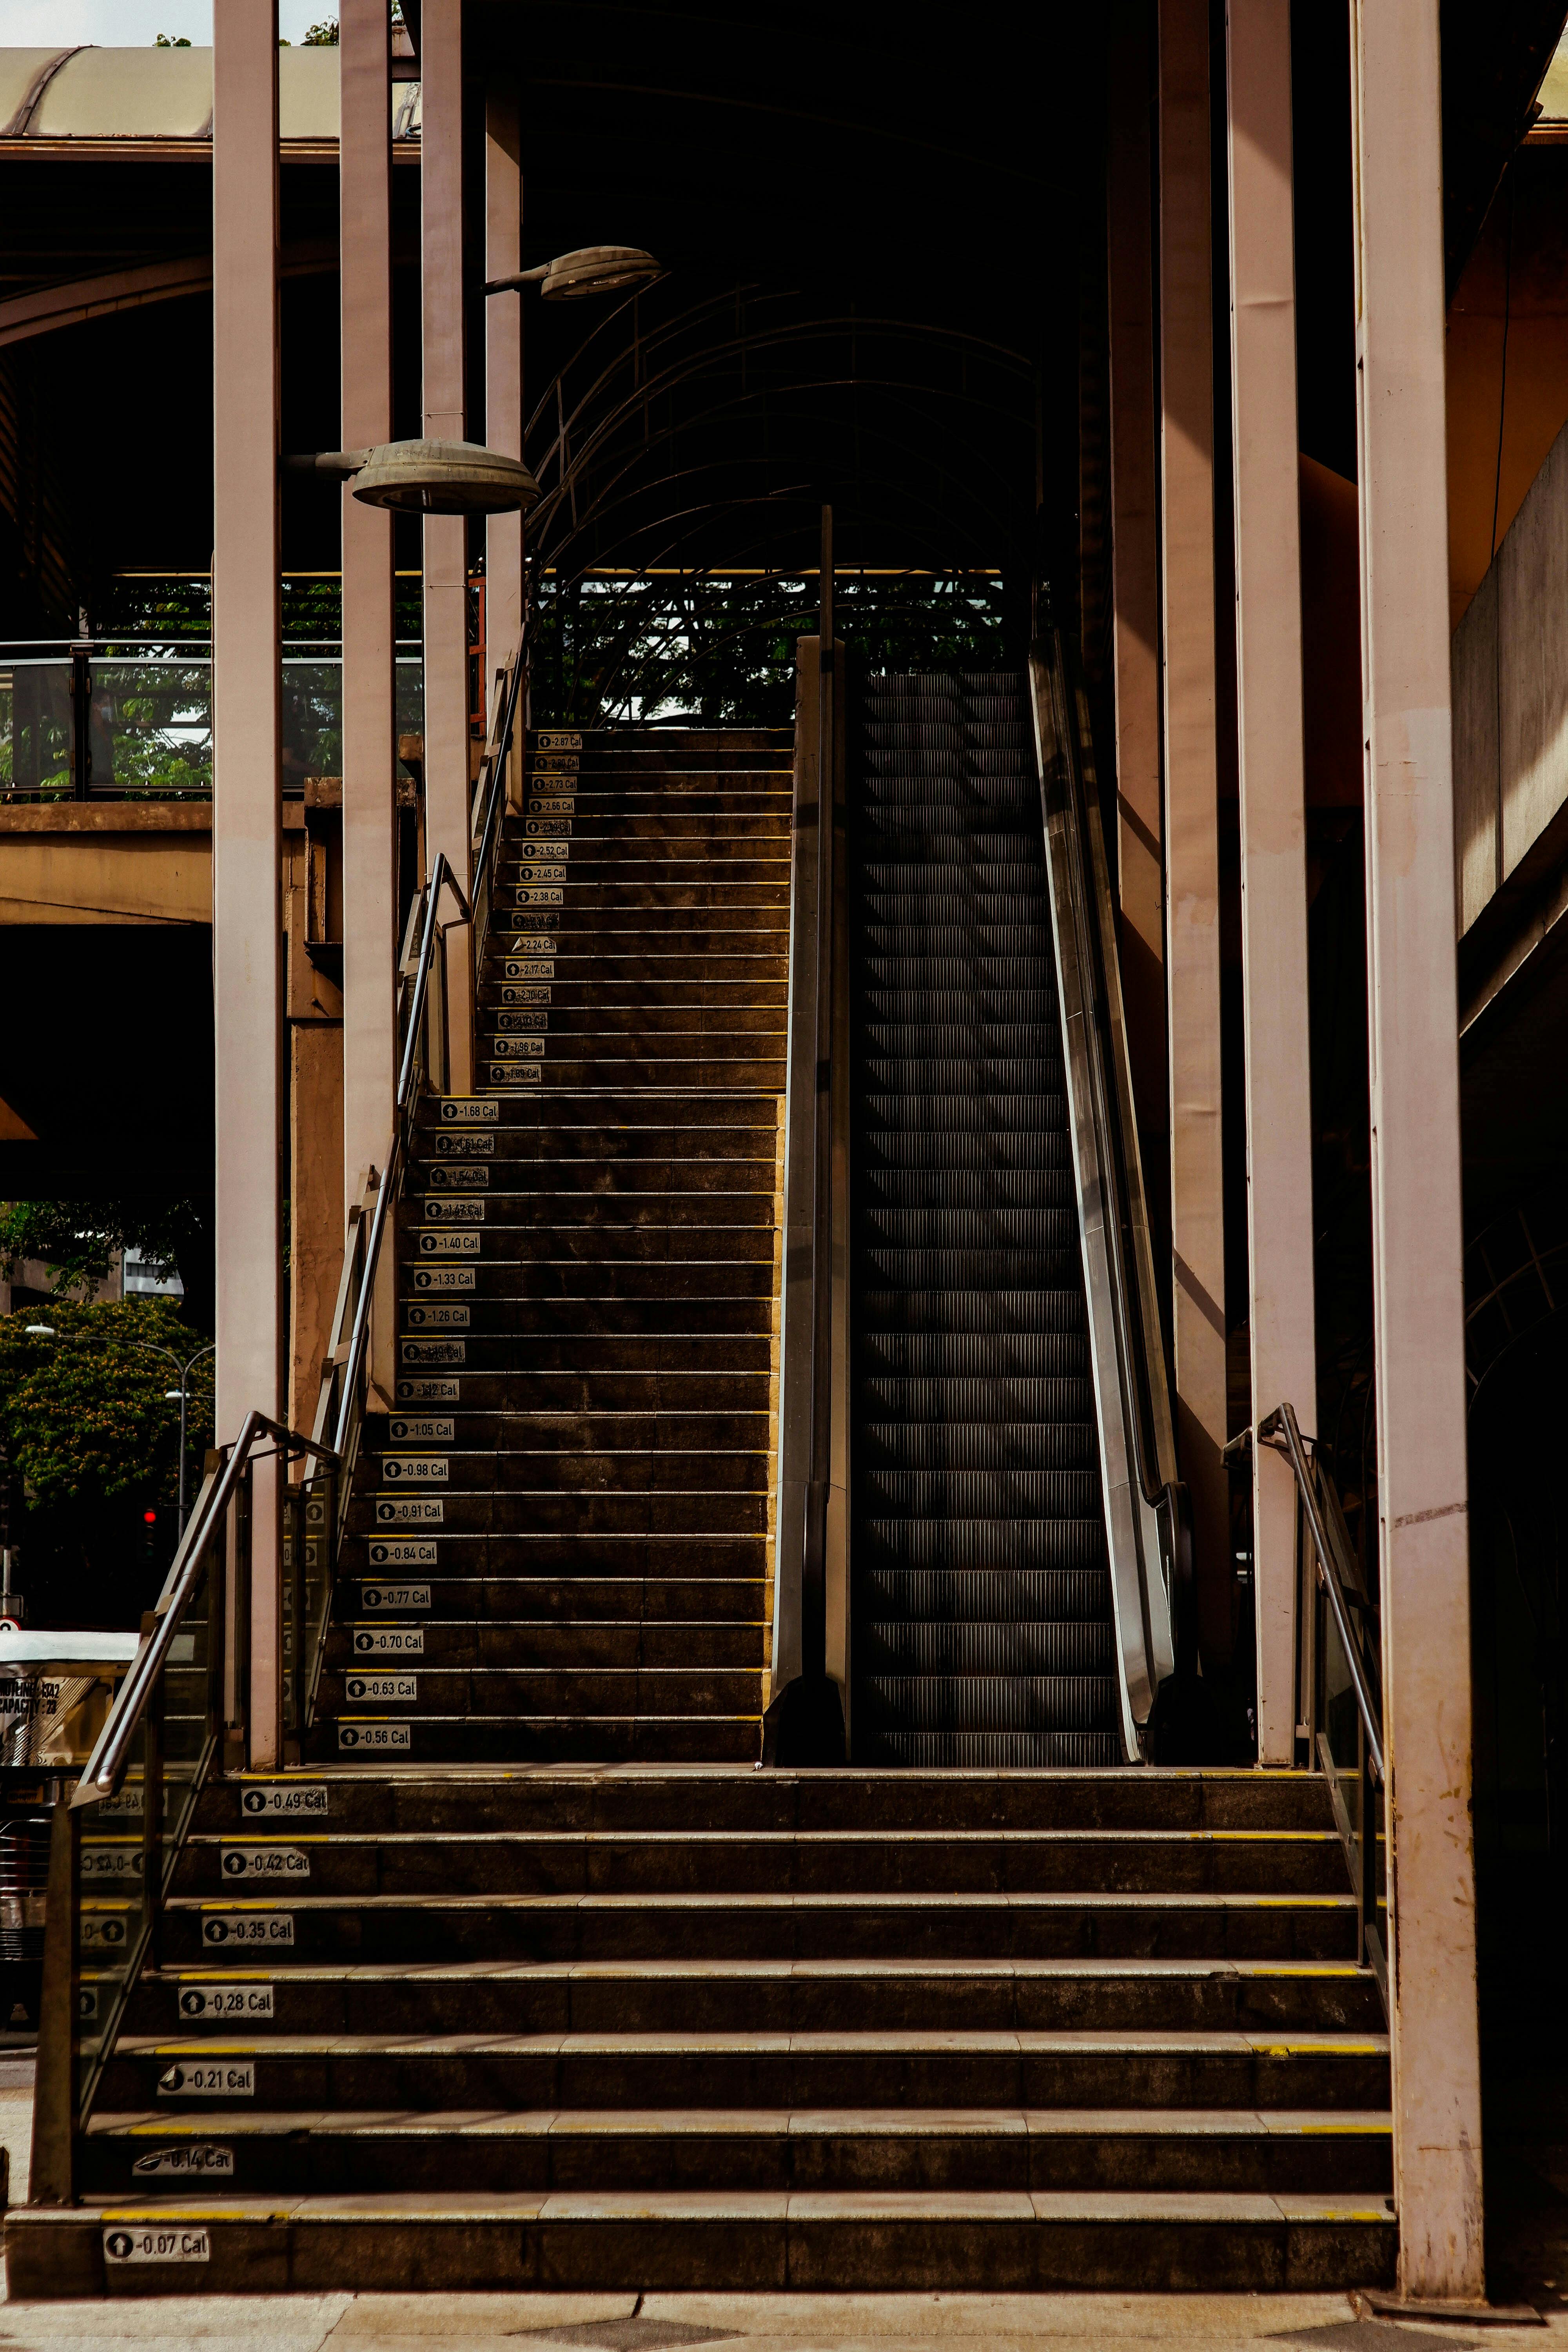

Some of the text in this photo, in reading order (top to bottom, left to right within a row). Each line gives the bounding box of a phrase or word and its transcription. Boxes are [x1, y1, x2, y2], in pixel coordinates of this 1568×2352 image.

[552, 738, 581, 746] -2.87 Cal
[543, 801, 573, 810] -2.66 Cal
[537, 846, 567, 855] -2.52 Cal
[534, 869, 565, 878] -2.45 Cal
[531, 892, 562, 901] -2.38 Cal
[523, 940, 555, 949] -2.24 Cal
[521, 965, 552, 974] -2.17 Cal
[511, 1042, 542, 1052] -1.96 Cal
[527, 1069, 539, 1078] Cal
[459, 1106, 496, 1117] -1.68 Cal
[472, 1171, 486, 1181] Cal
[444, 1204, 482, 1215] -1.47 Cal
[439, 1237, 477, 1249] -1.40 Cal
[434, 1273, 473, 1285] -1.33 Cal
[428, 1310, 467, 1322] -1.26 Cal
[441, 1384, 456, 1396] Cal
[410, 1424, 452, 1436] -1.05 Cal
[403, 1464, 446, 1476] -0.98 Cal
[397, 1505, 440, 1518] -0.91 Cal
[390, 1547, 435, 1560] -0.84 Cal
[383, 1591, 429, 1604] -0.77 Cal
[375, 1635, 422, 1649] -0.70 Cal
[368, 1682, 415, 1695] -0.63 Cal
[360, 1731, 408, 1744] -0.56 Cal
[267, 1792, 327, 1810] -0.49 Cal
[248, 1854, 308, 1871] -0.42 Cal
[230, 1922, 292, 1939] -0.35 Cal
[207, 1993, 271, 2011] -0.28 Cal
[187, 2071, 250, 2089] -0.21 Cal
[164, 2150, 230, 2169] -0.14 Cal
[136, 2235, 207, 2254] -0.07 Cal
